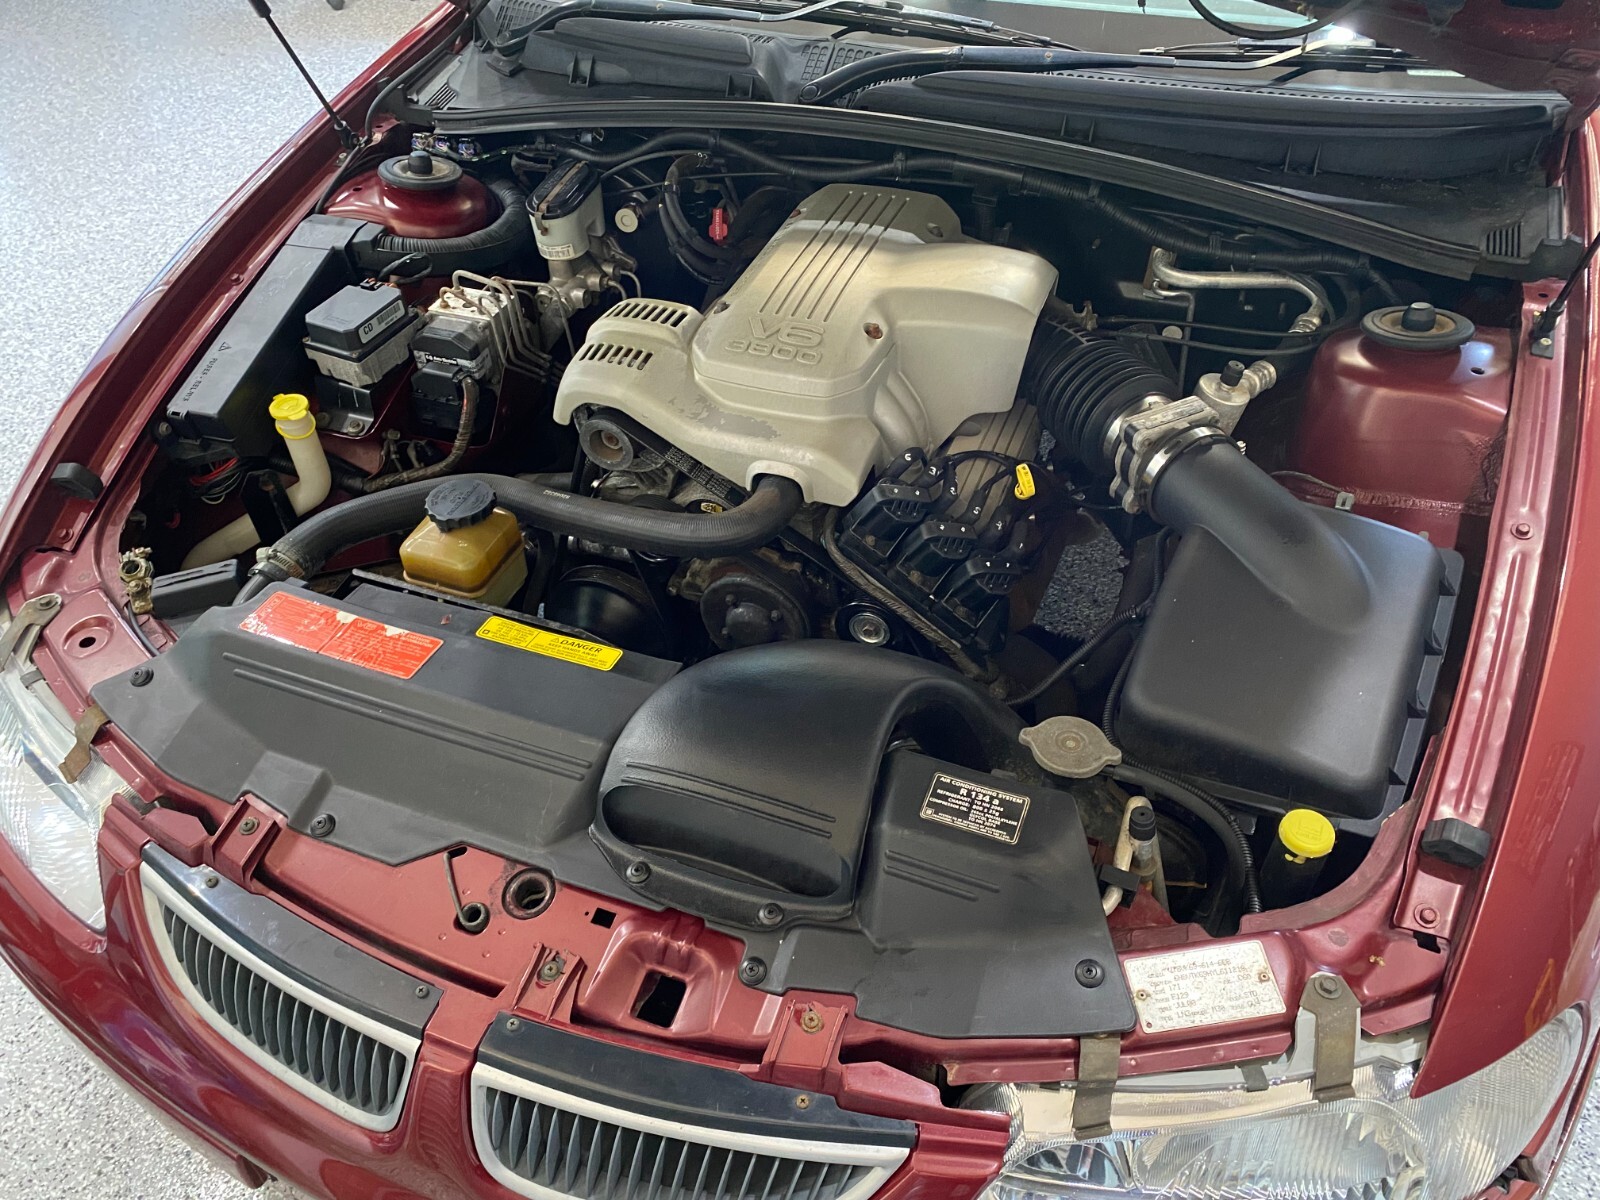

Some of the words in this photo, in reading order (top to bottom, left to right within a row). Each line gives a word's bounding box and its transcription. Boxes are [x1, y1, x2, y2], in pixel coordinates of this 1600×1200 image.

[363, 322, 374, 335] CD
[749, 318, 825, 348] V6
[725, 339, 822, 365] 3800
[560, 639, 603, 654] DANGER
[951, 780, 996, 796] CONDITIONING
[997, 793, 1022, 803] SYSTEM
[958, 787, 967, 796] R
[969, 791, 990, 802] 134
